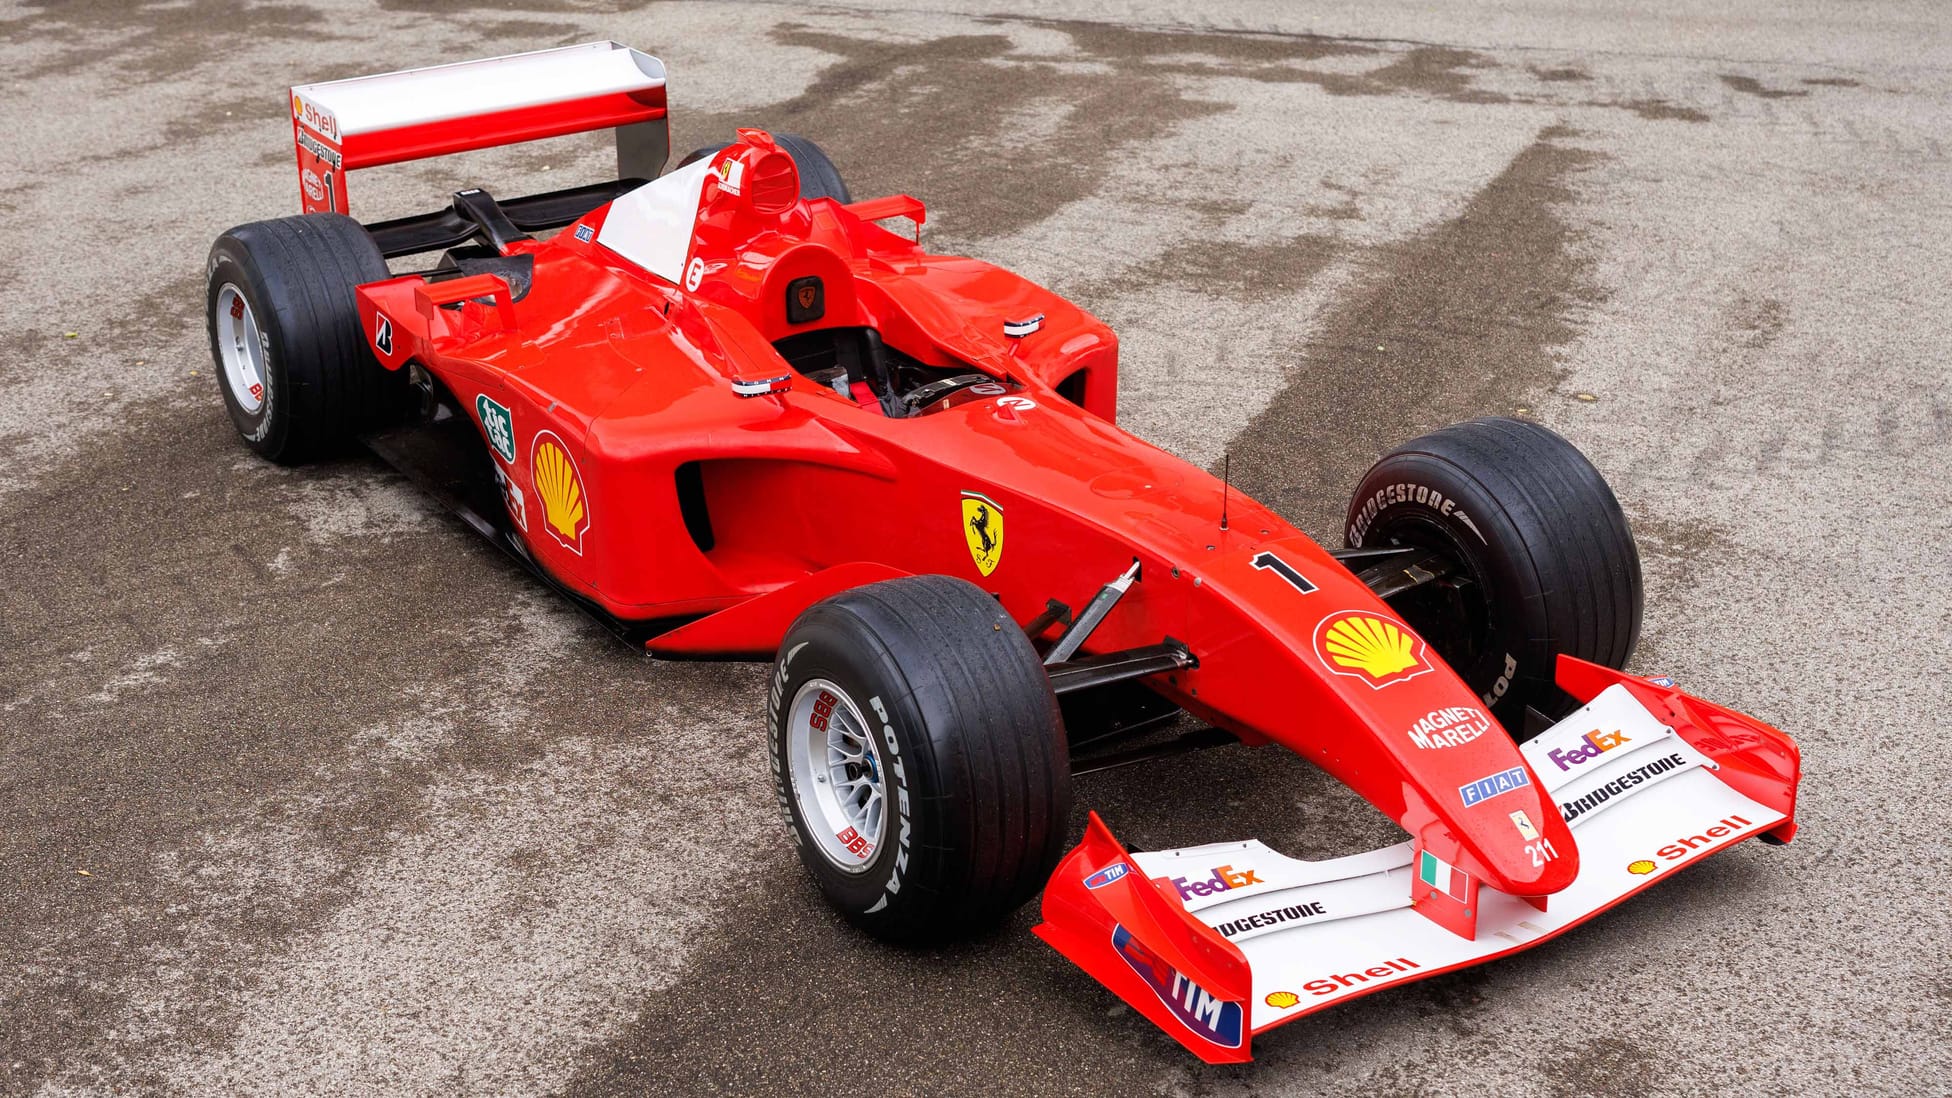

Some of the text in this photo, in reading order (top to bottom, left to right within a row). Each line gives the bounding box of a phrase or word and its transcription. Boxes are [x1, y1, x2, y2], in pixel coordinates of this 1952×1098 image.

[305, 103, 337, 136] Shell
[324, 170, 336, 213] 1
[689, 263, 698, 286] E
[483, 400, 508, 436] tic
[485, 418, 512, 460] tac
[1350, 483, 1456, 548] BRIDGESTONE
[1249, 550, 1320, 595] 1
[810, 690, 837, 732] BBS
[1408, 720, 1491, 750] MARELLI
[1547, 728, 1632, 772] FedEx
[869, 695, 911, 896] POTENZA
[1464, 770, 1525, 803] FIAT
[1561, 753, 1687, 823] BRIDGESTONE
[836, 826, 875, 860] BBS
[1524, 840, 1558, 867] 211
[1656, 815, 1753, 862] Shell
[1104, 866, 1125, 880] TIM
[1172, 865, 1265, 902] FedEx
[1212, 901, 1327, 938] DGESTONE
[1303, 958, 1421, 996] Shell
[1171, 971, 1224, 1033] TIM
